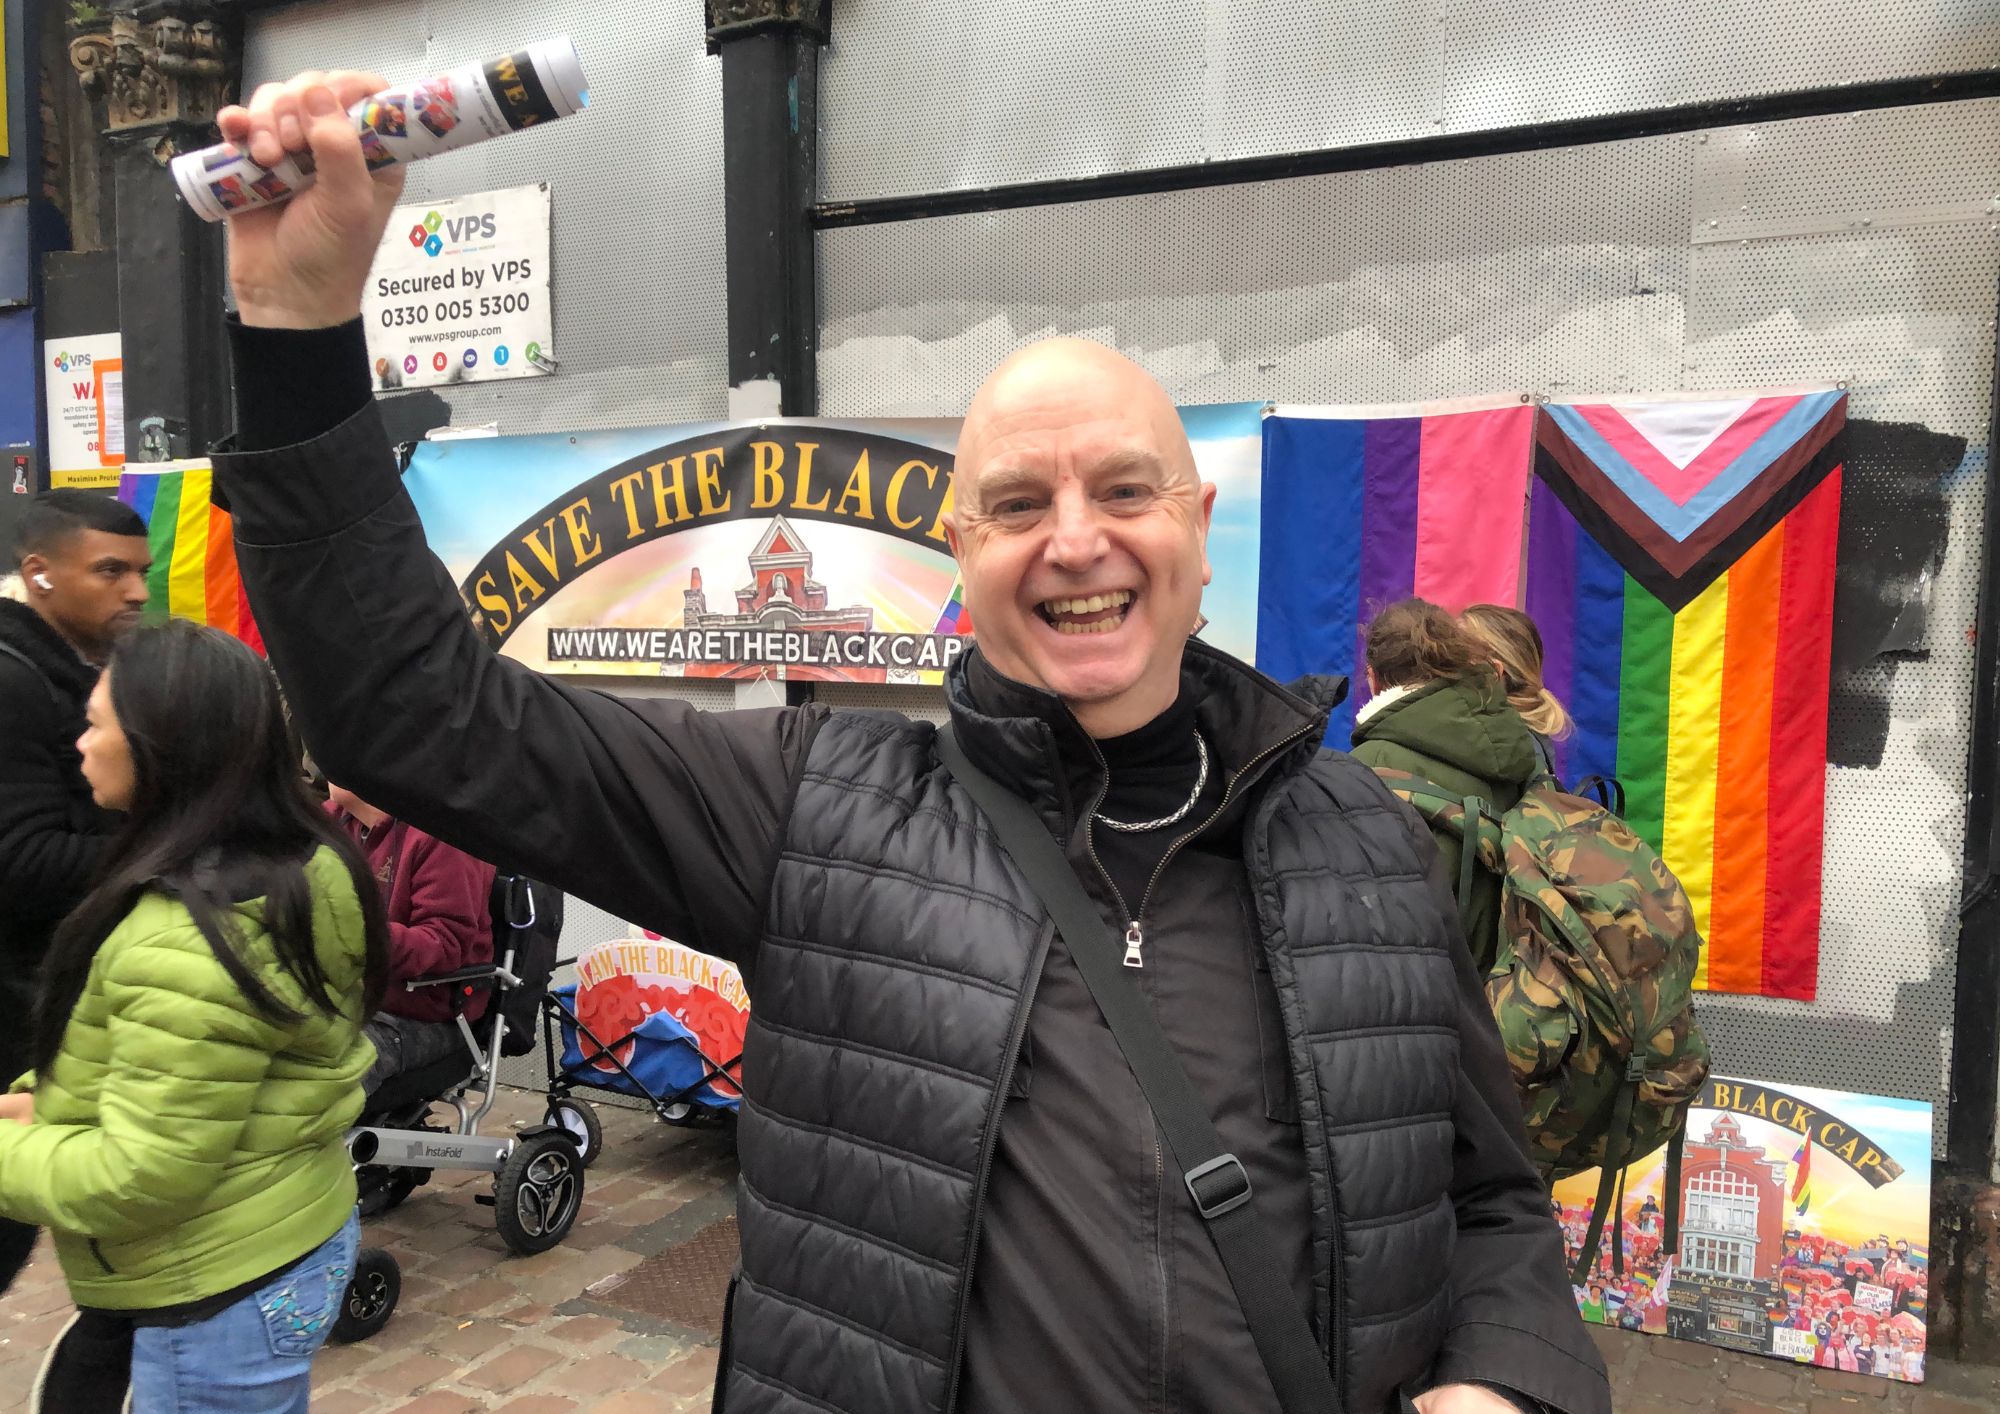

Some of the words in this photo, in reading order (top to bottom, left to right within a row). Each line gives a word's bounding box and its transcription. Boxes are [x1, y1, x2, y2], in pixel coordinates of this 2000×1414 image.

[446, 213, 496, 243] VPS
[378, 268, 455, 297] Secured
[462, 266, 485, 289] by
[492, 259, 531, 282] VPS
[381, 305, 428, 328] 0330
[435, 300, 473, 322] 005
[480, 292, 530, 316] 5300
[409, 326, 502, 344] www.vpsgroup.com
[70, 353, 91, 367] VPS
[475, 496, 602, 636] SAVE
[610, 447, 731, 540] THE
[589, 950, 616, 984] AM
[618, 945, 652, 975] THE
[656, 947, 714, 989] BLACK
[1714, 1083, 1816, 1133] BLACK
[1820, 1122, 1882, 1170] CAP
[425, 1146, 462, 1158] InstaFold
